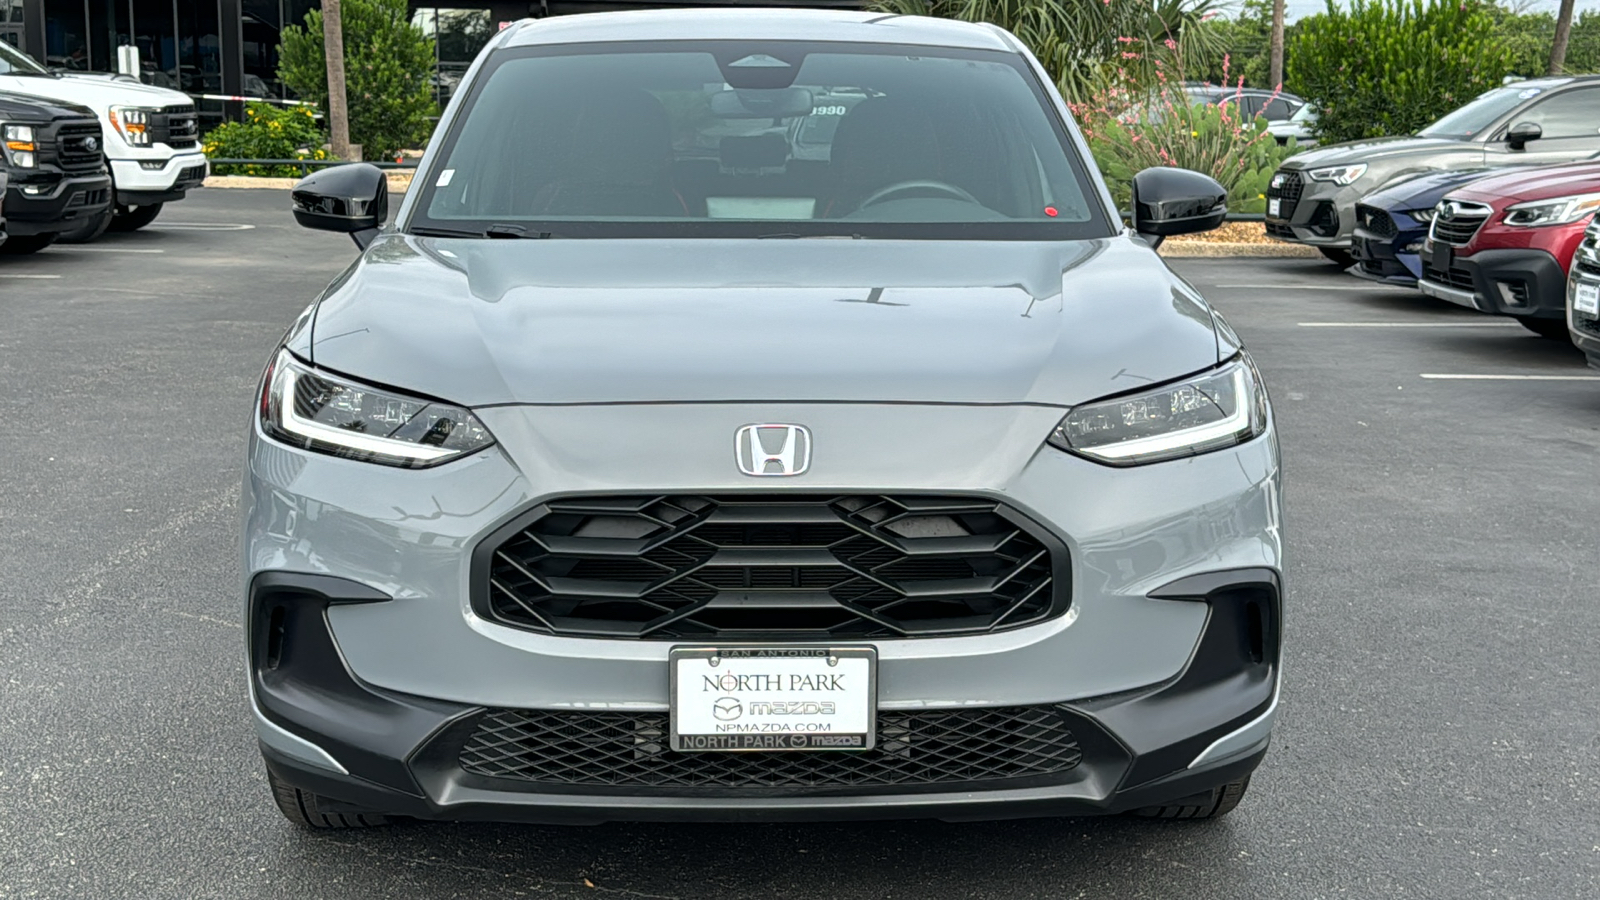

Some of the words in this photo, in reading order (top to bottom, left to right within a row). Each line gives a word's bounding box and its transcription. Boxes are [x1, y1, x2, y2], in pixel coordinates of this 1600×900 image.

[721, 649, 751, 658] SAN
[759, 649, 826, 658] ANTONIO
[702, 673, 781, 692] NORTH
[789, 673, 846, 692] PARK
[749, 701, 836, 715] mazda
[716, 723, 831, 732] NPMAZDA.COM
[683, 735, 739, 749] NORTH
[744, 735, 786, 748] PARK
[811, 735, 862, 746] mazda
